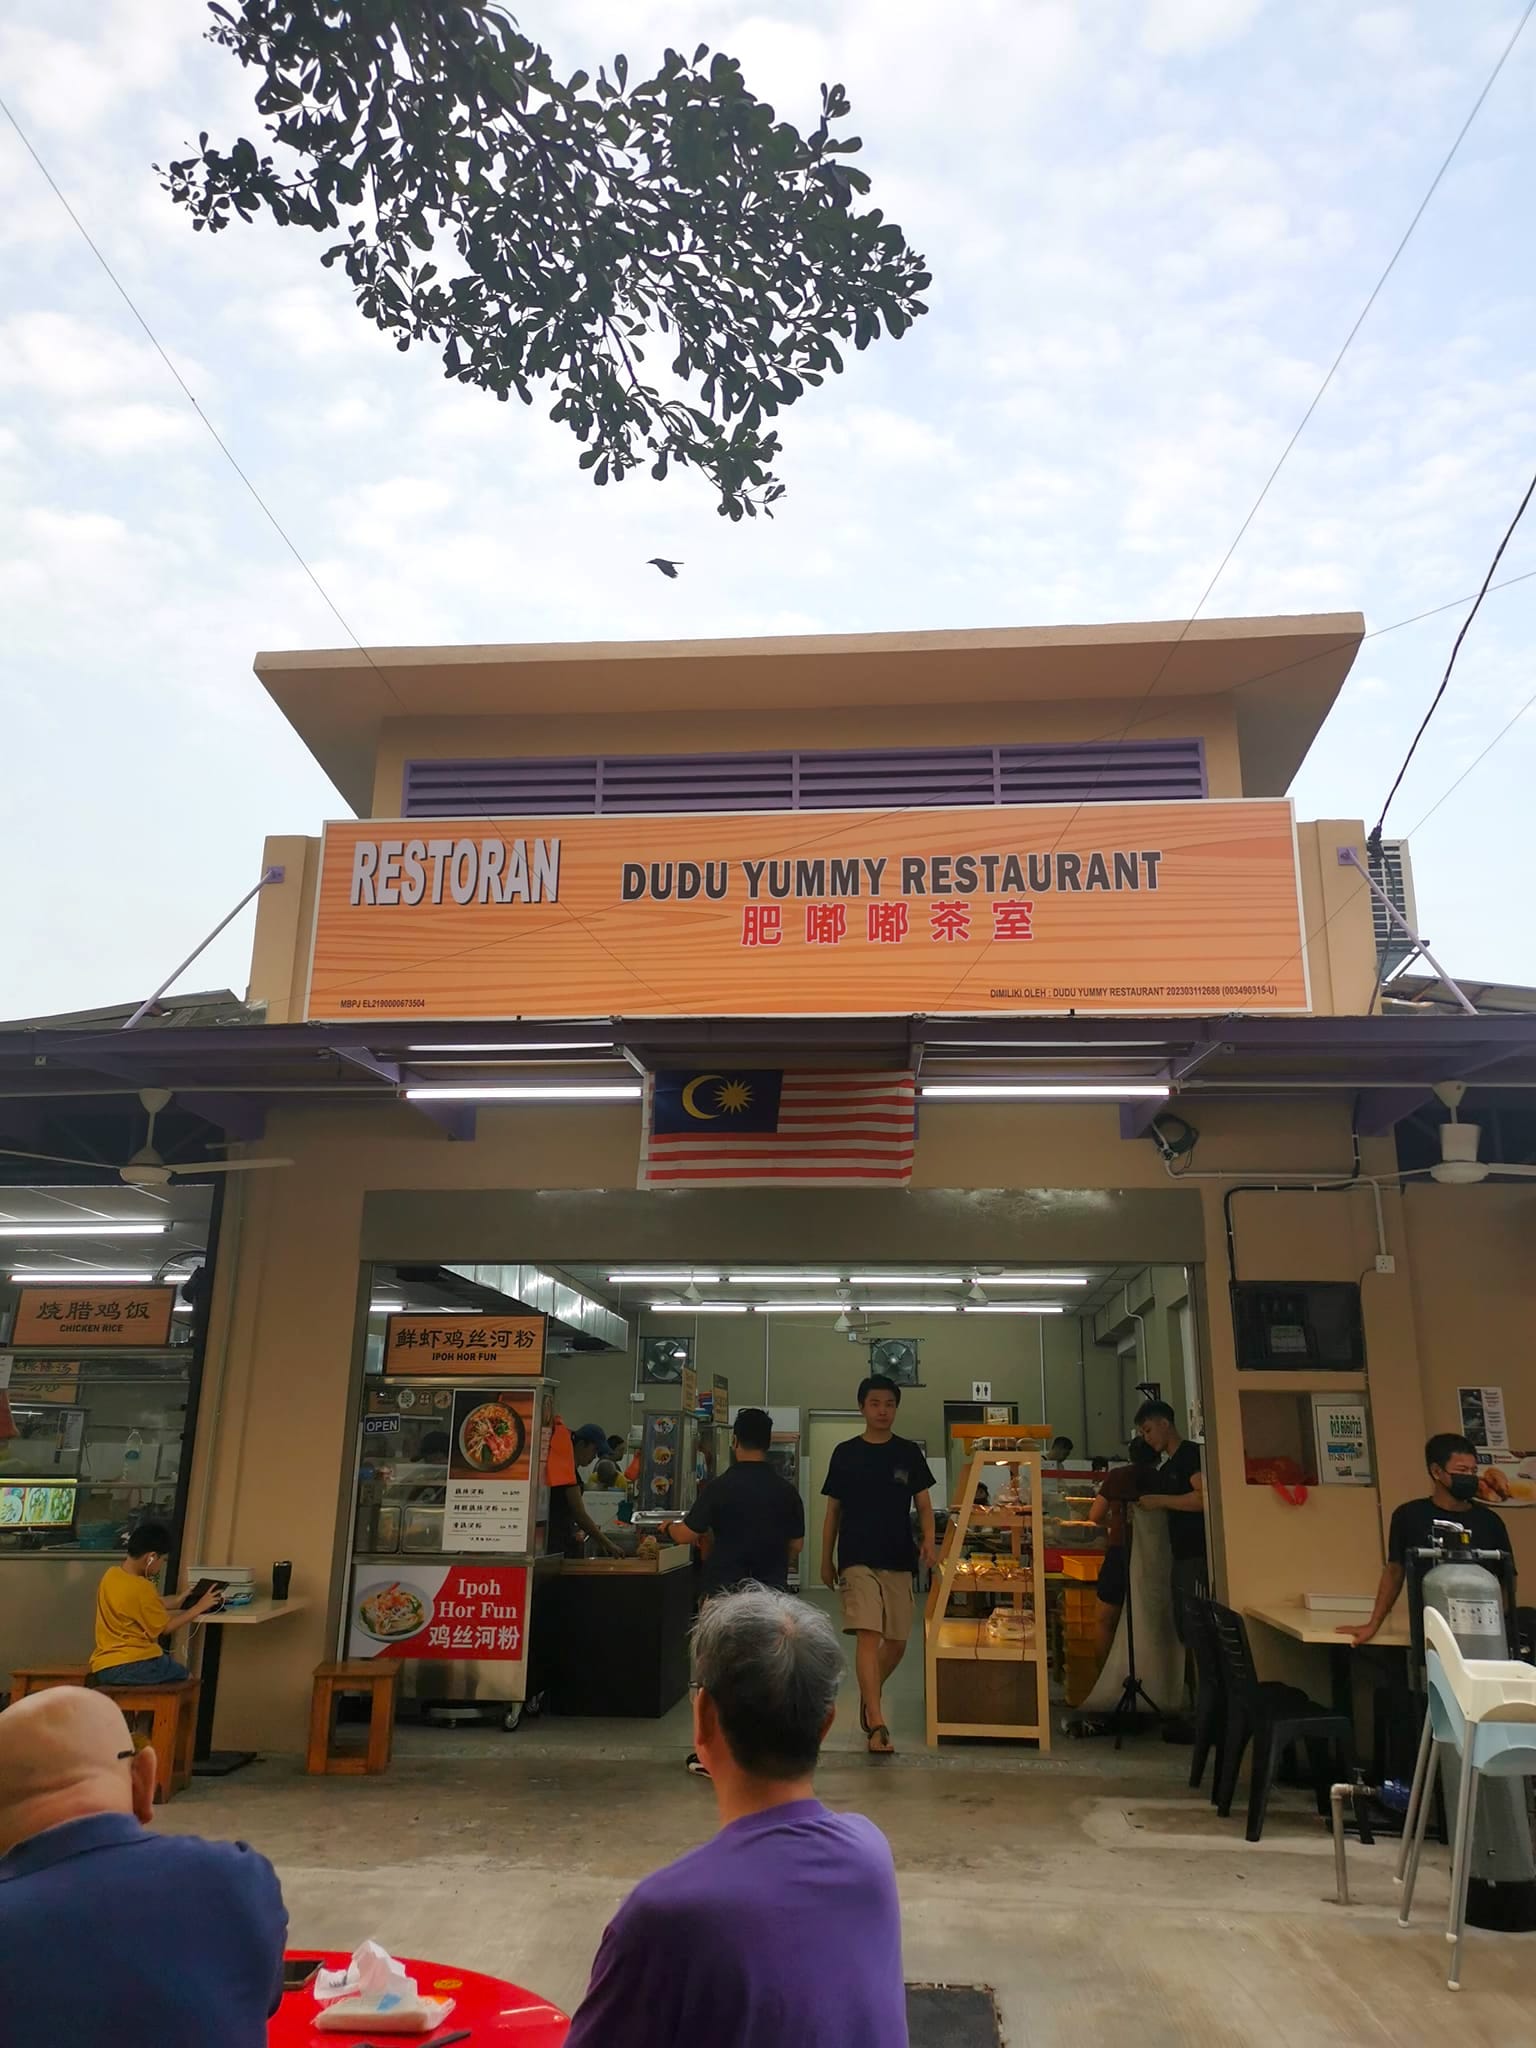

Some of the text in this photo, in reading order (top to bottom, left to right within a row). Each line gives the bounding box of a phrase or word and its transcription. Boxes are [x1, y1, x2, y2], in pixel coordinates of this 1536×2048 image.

[350, 838, 562, 906] RESTORAN
[621, 850, 1162, 901] DUDU YUMMY RESTAURANT
[741, 899, 1035, 947] 肥嘟嘟茶室
[990, 988, 1022, 998] DIMILIKI
[1024, 988, 1046, 998] OLEH
[1053, 988, 1076, 997] DUDU
[1078, 987, 1107, 997] YUMMY
[1109, 986, 1165, 997] RESTAURANT
[340, 999, 361, 1009] MBPJ
[36, 1301, 151, 1320] 烧腊鸡饭
[59, 1323, 125, 1333] CHICKEN RICE
[394, 1328, 537, 1349] 鲜虾鸡丝河粉
[431, 1352, 497, 1361] IPOH HOR FUN
[366, 1419, 398, 1432] OPEN
[457, 1578, 501, 1599] Ipoh
[438, 1601, 518, 1619] Hor Fun
[428, 1625, 520, 1650] 鸡丝河粉
